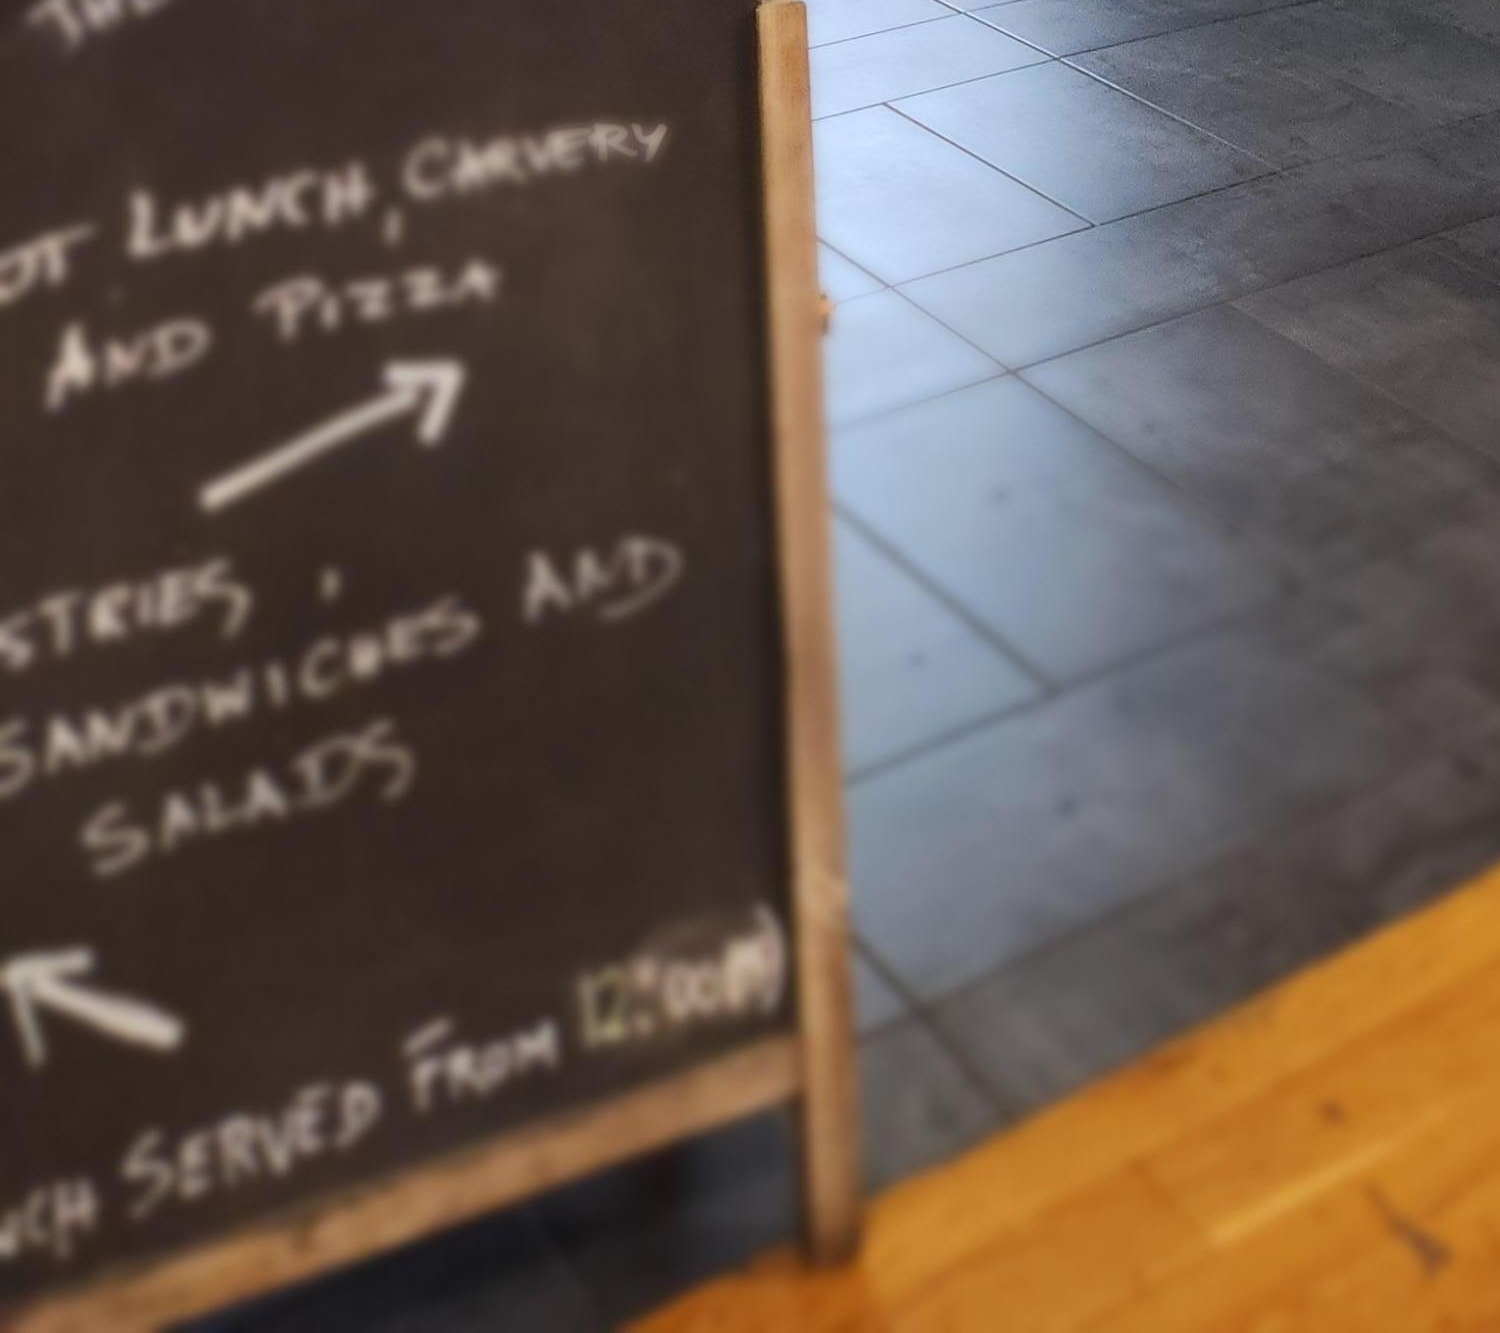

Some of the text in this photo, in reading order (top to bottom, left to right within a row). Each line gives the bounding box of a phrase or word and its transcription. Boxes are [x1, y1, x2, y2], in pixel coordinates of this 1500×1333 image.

[0, 221, 98, 301] OT
[45, 259, 503, 413] AND PIZZA
[0, 555, 253, 673] STRIES
[522, 533, 686, 625] AND
[80, 719, 416, 878] SALADS
[120, 1077, 383, 1220] SERVED
[402, 1017, 562, 1113] FROM
